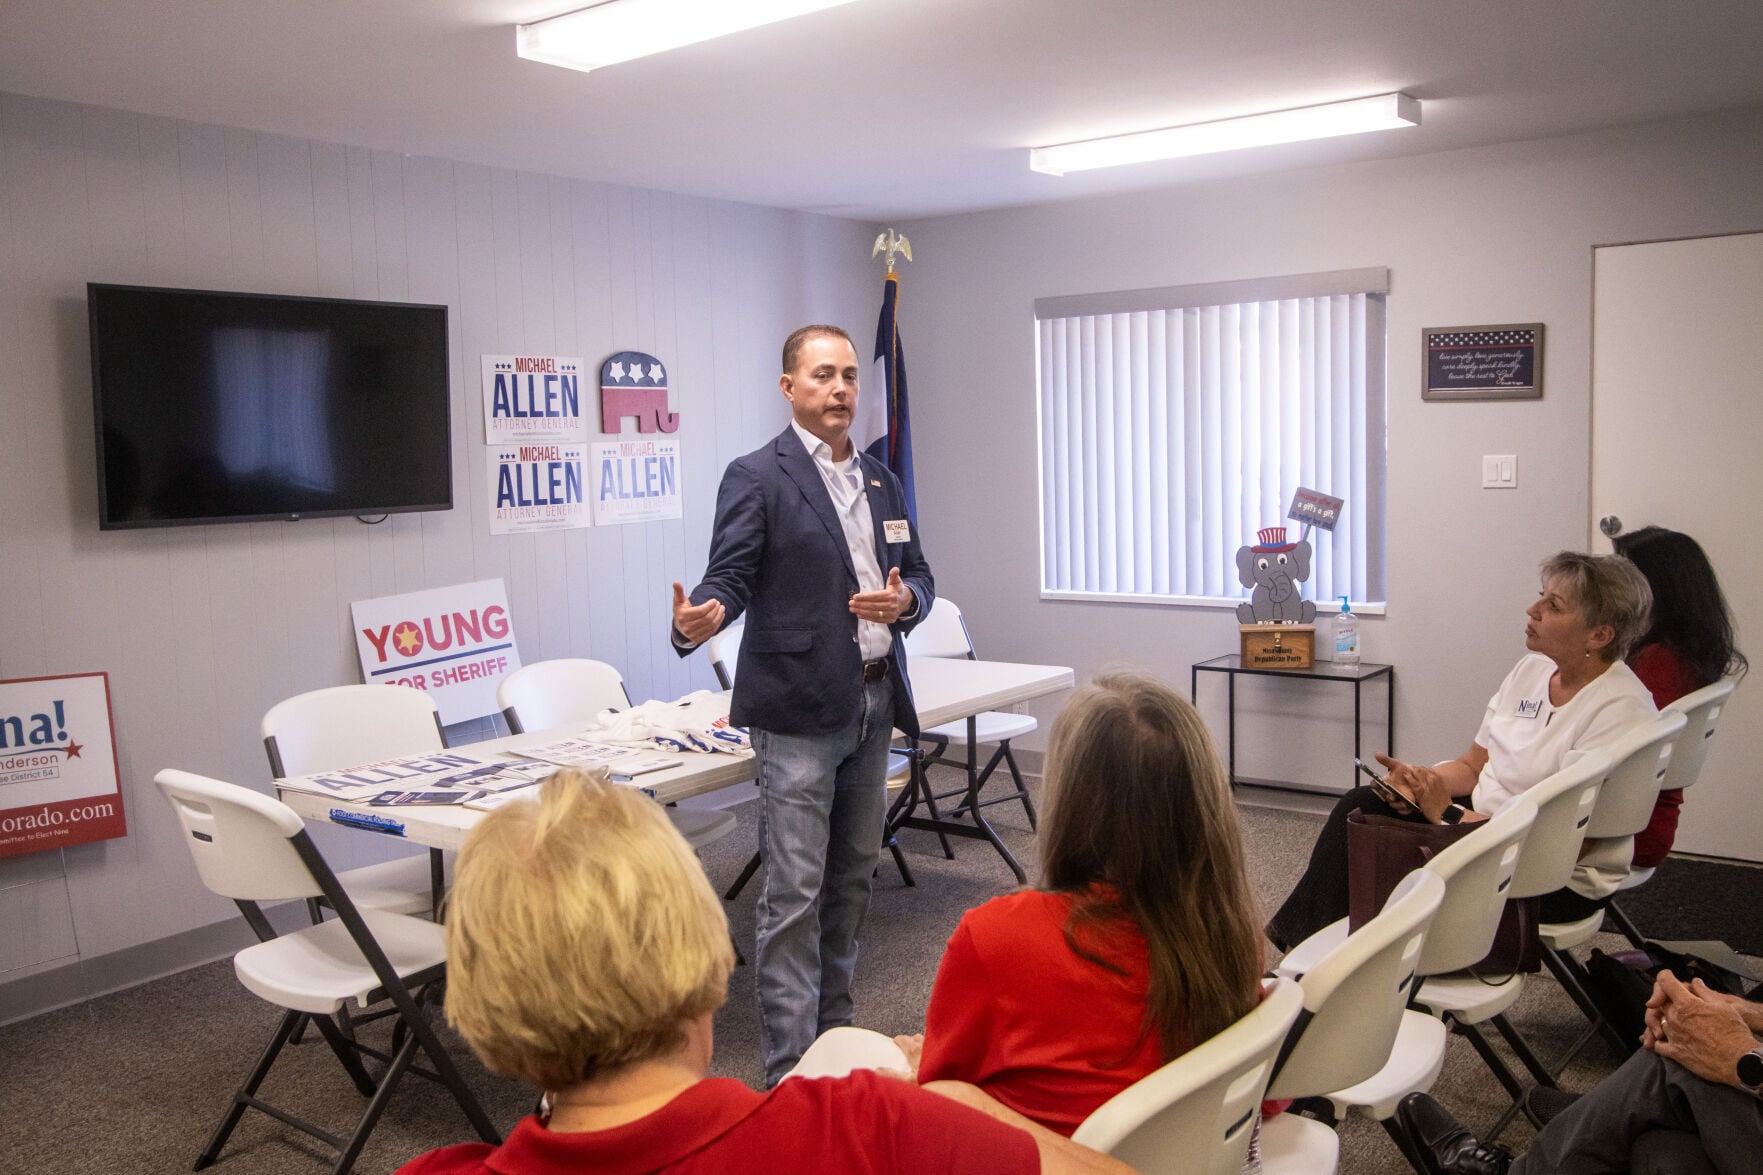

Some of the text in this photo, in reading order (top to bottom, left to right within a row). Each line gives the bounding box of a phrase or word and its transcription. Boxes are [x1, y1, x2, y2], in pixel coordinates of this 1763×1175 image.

[515, 357, 558, 374] MICHAEL
[492, 373, 579, 418] ALLEN
[492, 418, 581, 430] ATTORNEY GENERAL
[519, 445, 562, 462] MICHAEL
[620, 441, 657, 457] MICHAEL
[497, 462, 583, 508] ALLEN
[600, 455, 676, 501] ALLEN
[496, 504, 584, 520] ATTORNEY GENERAL
[885, 523, 907, 531] MICHAEL
[362, 605, 509, 663] YOUNG
[385, 656, 508, 691] OR SHERIFF
[11, 770, 41, 781] District
[313, 754, 483, 791] ALLEN
